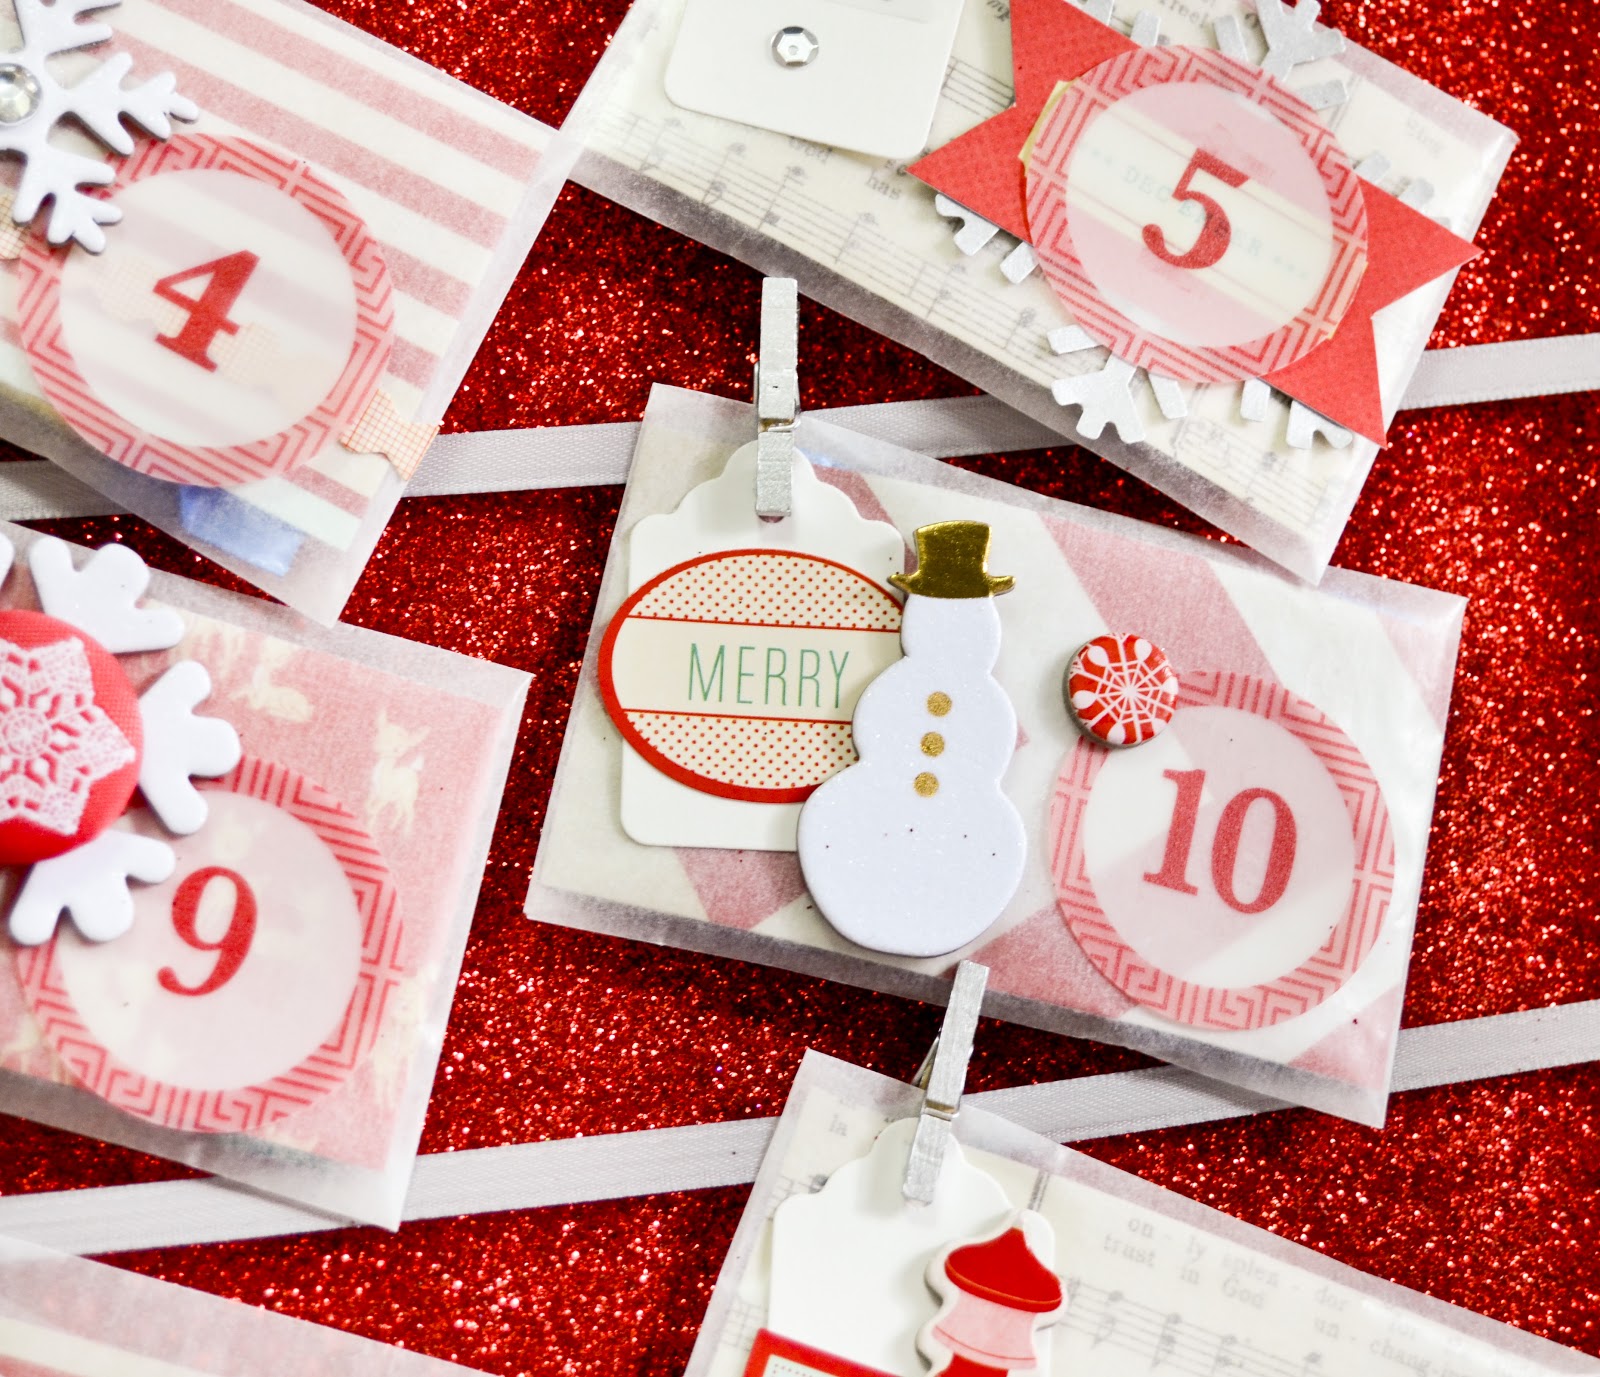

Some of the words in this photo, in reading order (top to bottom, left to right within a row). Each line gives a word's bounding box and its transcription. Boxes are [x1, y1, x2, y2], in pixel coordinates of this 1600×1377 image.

[1142, 148, 1250, 270] 5
[152, 249, 260, 373] 4
[688, 642, 850, 709] MERRY
[1143, 768, 1297, 914] 10
[157, 866, 258, 997] 9
[1103, 1233, 1156, 1268] trust
[1180, 1262, 1201, 1286] in
[1221, 1273, 1265, 1309] God
